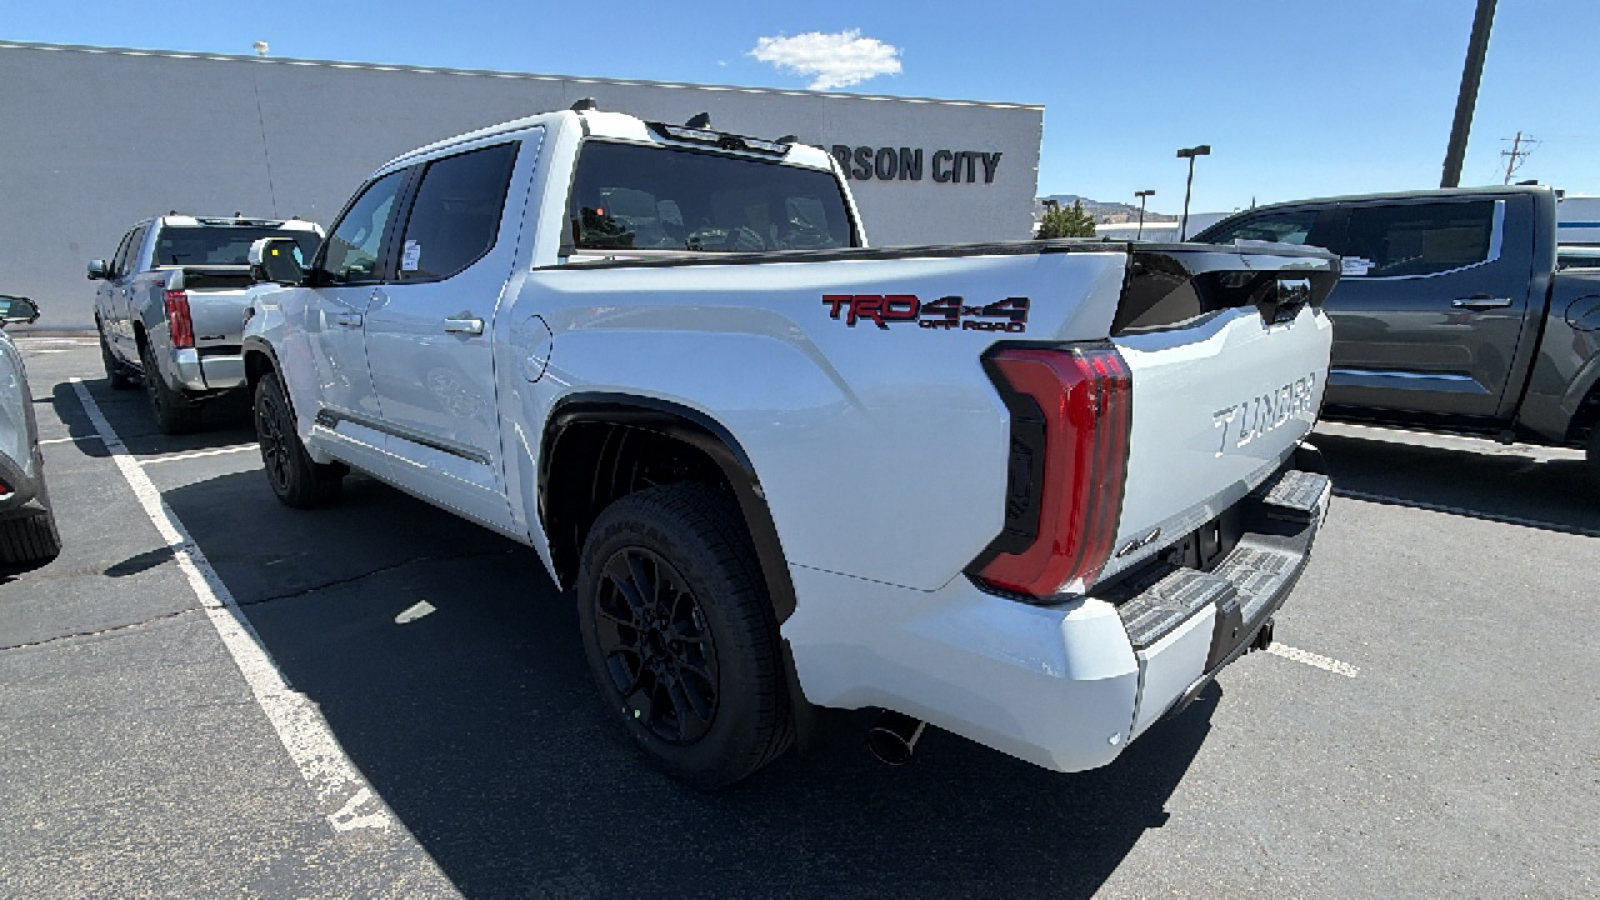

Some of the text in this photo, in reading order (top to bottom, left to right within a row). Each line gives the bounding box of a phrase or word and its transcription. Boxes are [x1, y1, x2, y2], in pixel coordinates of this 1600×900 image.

[932, 150, 1003, 183] CITY
[821, 294, 920, 331] TRD
[919, 319, 1026, 333] OFF ROAD
[1212, 371, 1316, 459] TUNDRA
